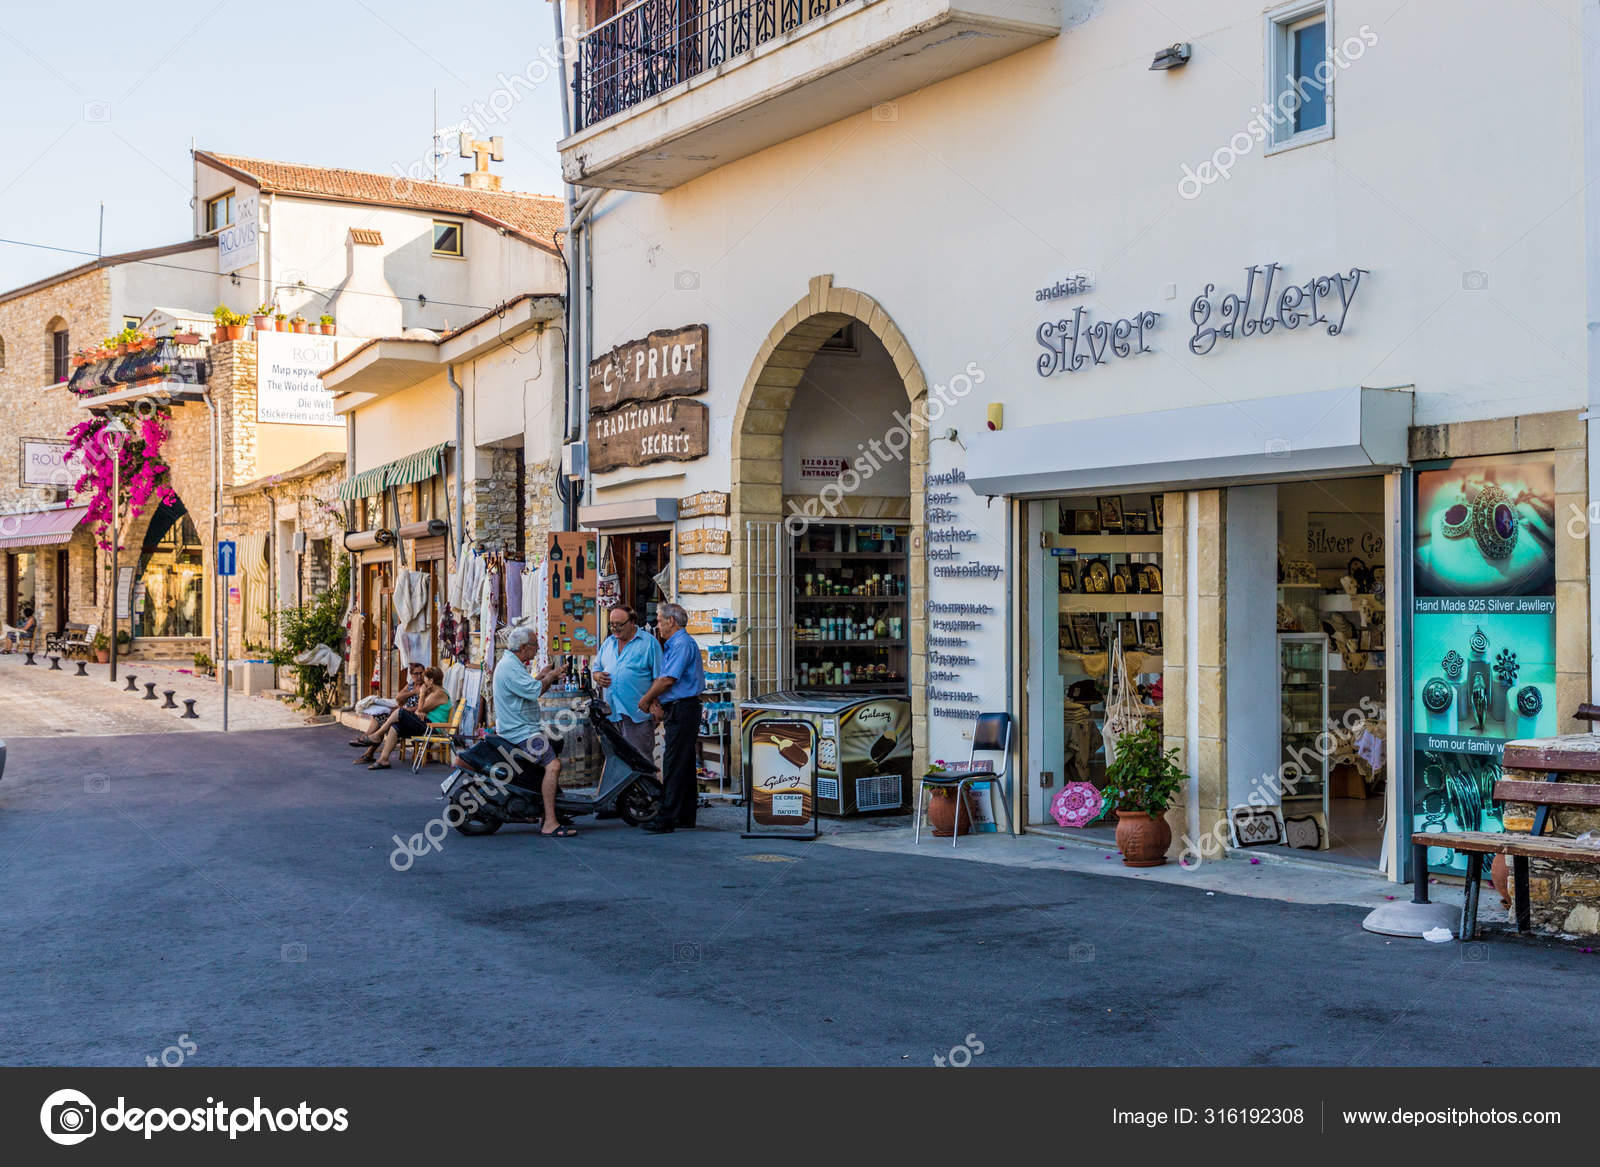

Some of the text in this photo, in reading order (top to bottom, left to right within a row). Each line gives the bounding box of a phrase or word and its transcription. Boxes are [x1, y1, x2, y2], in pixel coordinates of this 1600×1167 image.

[1188, 262, 1364, 356] gallery
[267, 380, 282, 390] The
[284, 380, 308, 392] World
[310, 384, 319, 392] of
[298, 398, 331, 408] Die Welt
[309, 412, 325, 421] und
[595, 404, 673, 439] TRADITIONAL
[641, 434, 690, 455] SECRETS
[1307, 528, 1354, 553] Silver
[933, 560, 1001, 581] embroidery
[1416, 599, 1555, 615] Hand Made 925 Silver Jewllery
[859, 708, 891, 723] Galaxy
[1429, 736, 1449, 749] from
[1450, 740, 1465, 750] our
[1468, 739, 1495, 755] family
[764, 774, 800, 790] Galaxy
